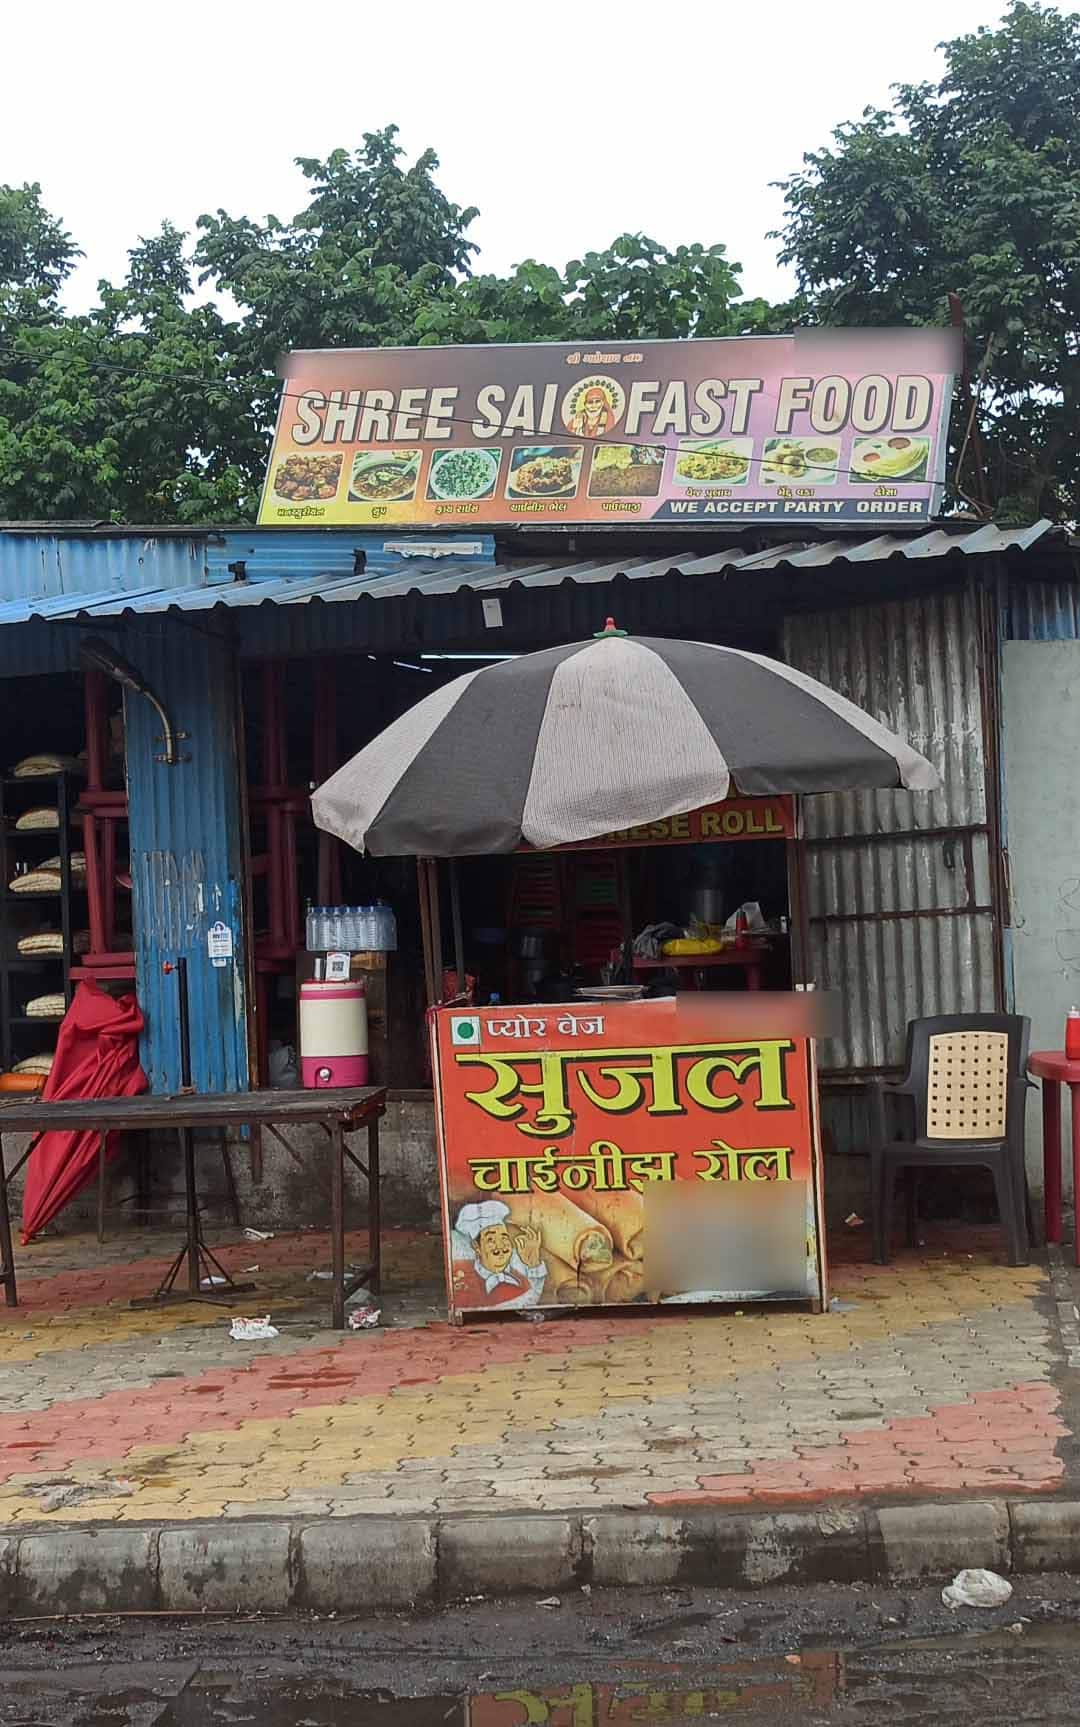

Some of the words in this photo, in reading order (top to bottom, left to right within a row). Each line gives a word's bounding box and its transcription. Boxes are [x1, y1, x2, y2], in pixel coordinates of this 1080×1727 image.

[291, 387, 459, 445] SHREE
[472, 383, 559, 438] SAI
[624, 378, 763, 436] FAST
[774, 375, 934, 434] FOOD
[669, 501, 699, 513] WE
[704, 501, 781, 513] ACCEPT
[784, 501, 845, 513] PARTY
[856, 501, 923, 513] ORDER
[701, 808, 784, 836] ROLL
[486, 1015, 547, 1038] प्योर
[557, 1013, 606, 1036] वेज
[454, 1040, 796, 1138] सुजल
[692, 1140, 795, 1182] रोल
